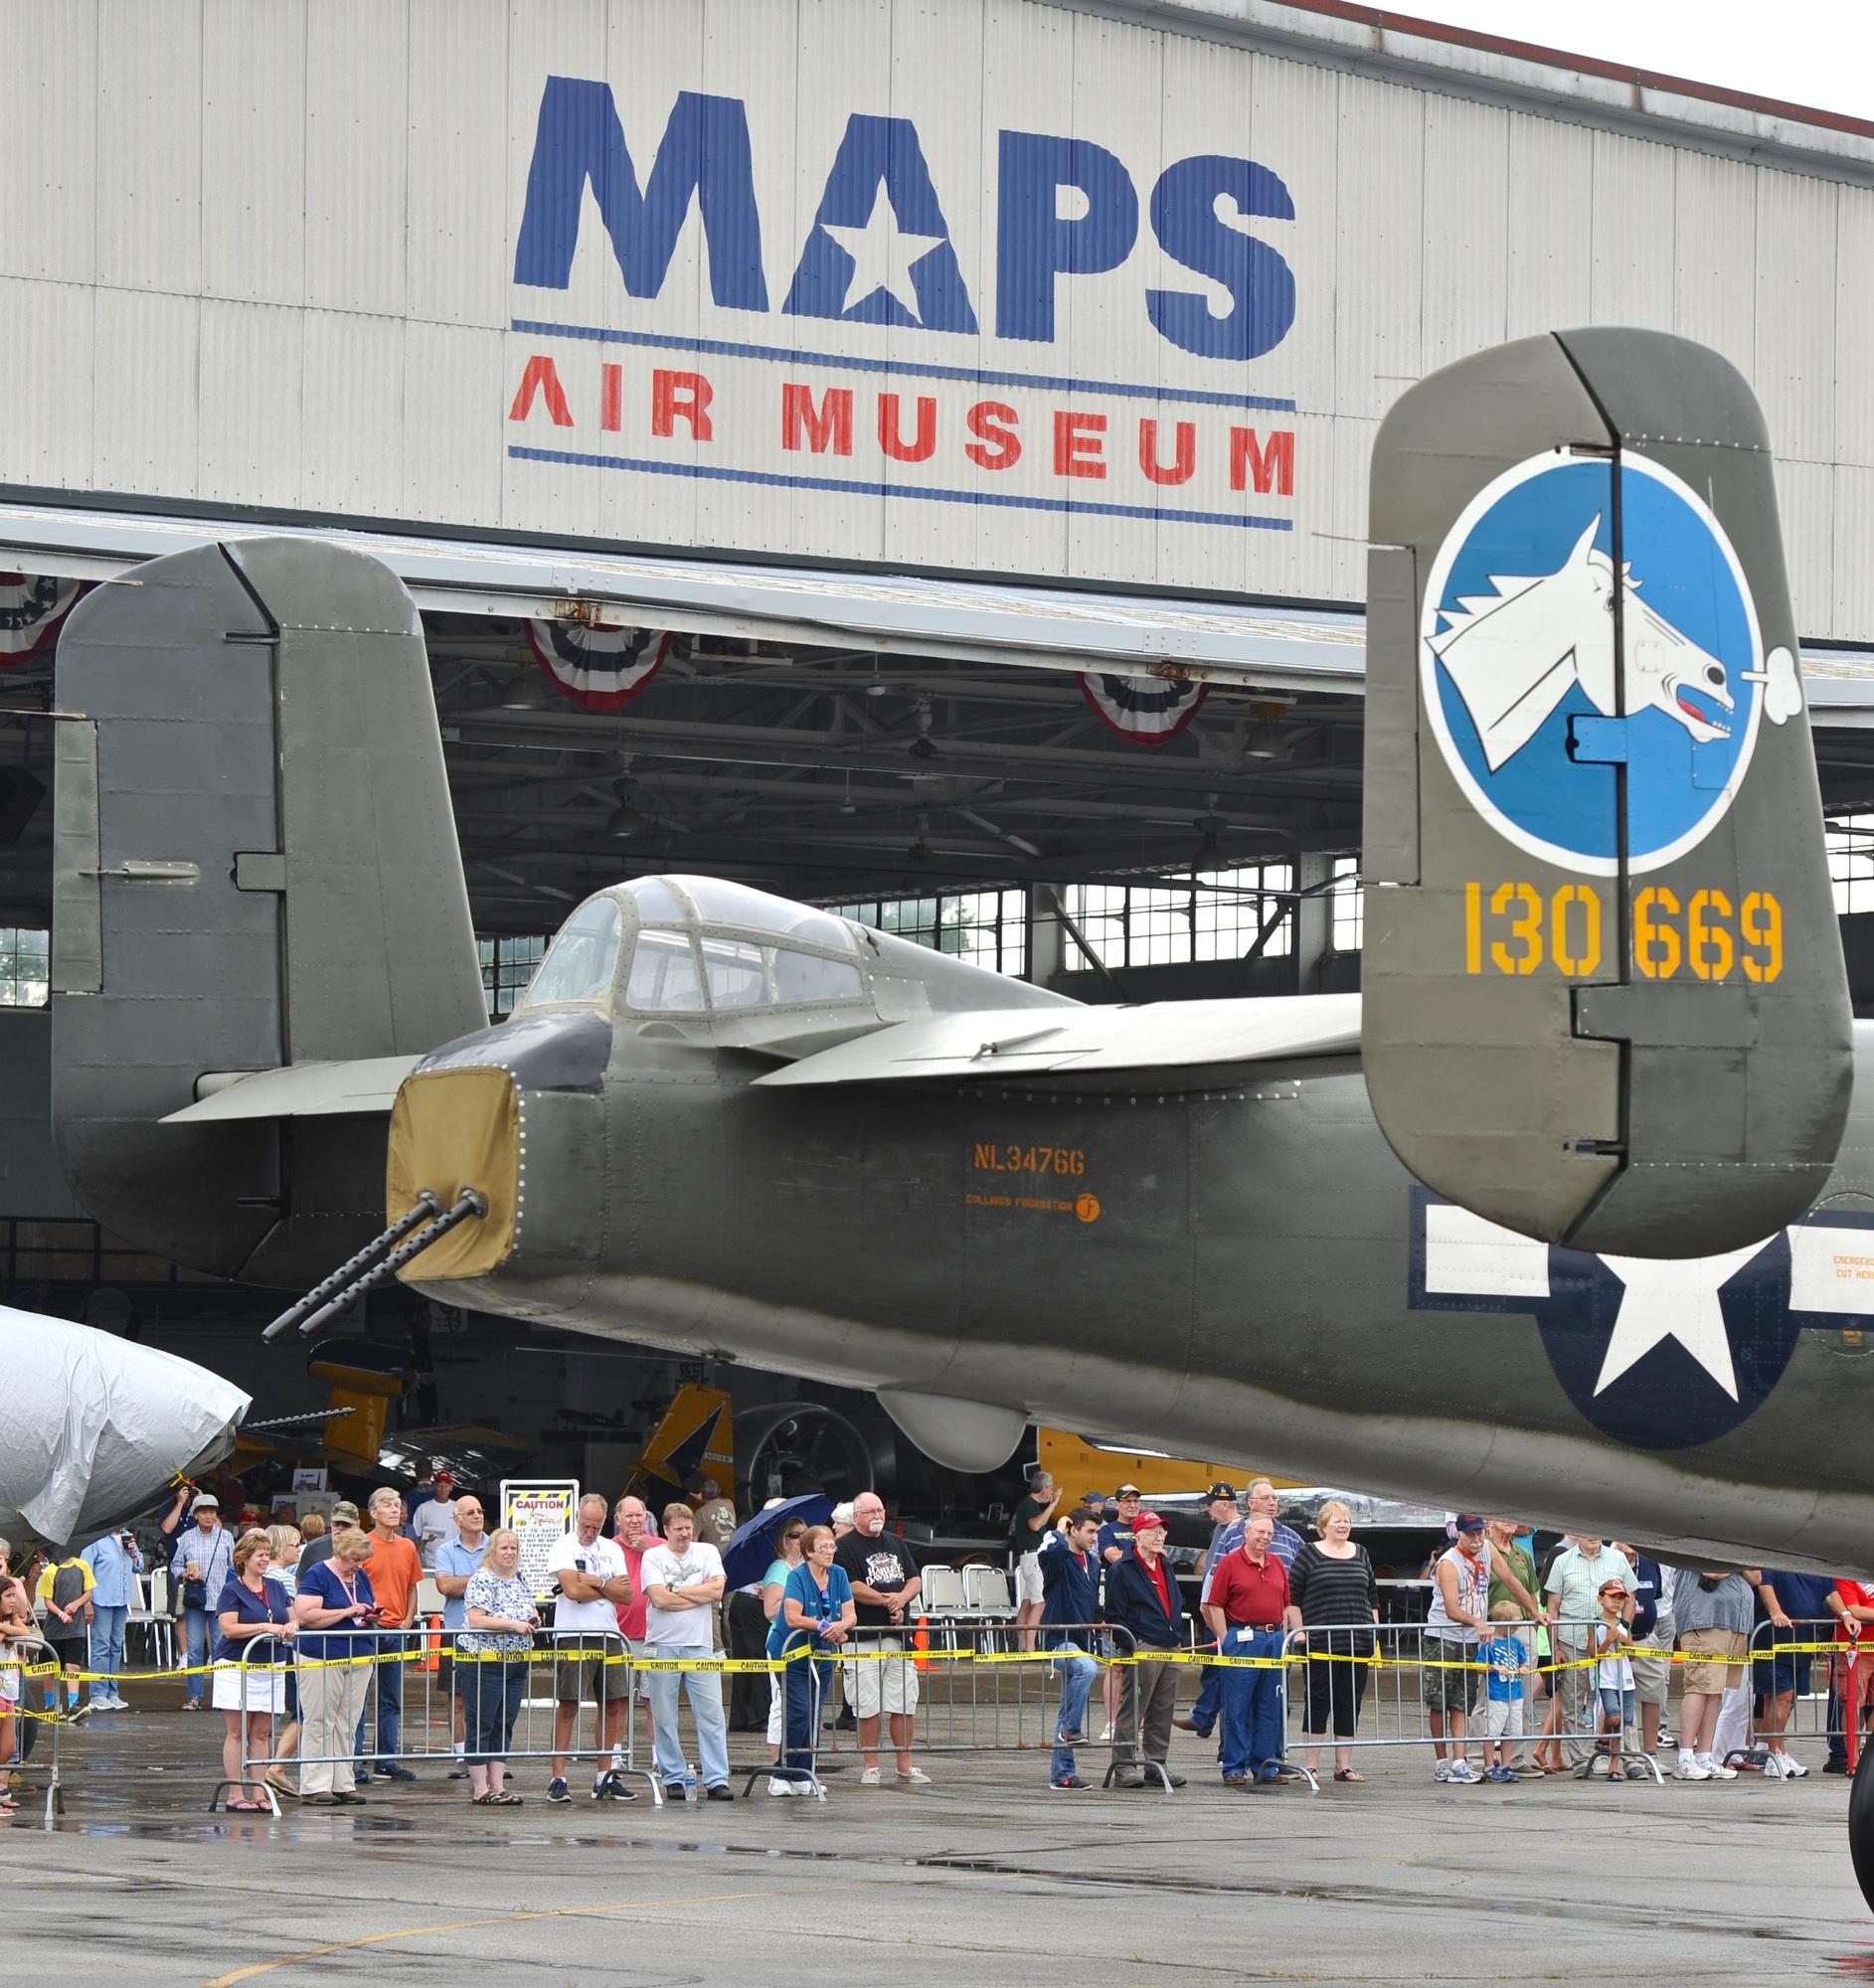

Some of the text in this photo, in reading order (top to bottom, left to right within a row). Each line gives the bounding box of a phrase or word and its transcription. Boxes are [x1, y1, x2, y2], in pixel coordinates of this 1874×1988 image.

[512, 74, 1296, 362] MAPS
[509, 355, 1295, 497] AIR MUSEUM
[974, 1143, 1085, 1176] NL3476G
[1015, 1196, 1074, 1211] FOUNDATION
[1833, 1255, 1874, 1265] EMERGENC
[1836, 1269, 1874, 1279] CUT HER
[515, 1500, 565, 1509] CAUTION
[650, 1661, 768, 1671] CAUTION CAUTION CAUTION
[1187, 1654, 1215, 1663] CAUTION
[1229, 1657, 1256, 1666] CAUTION
